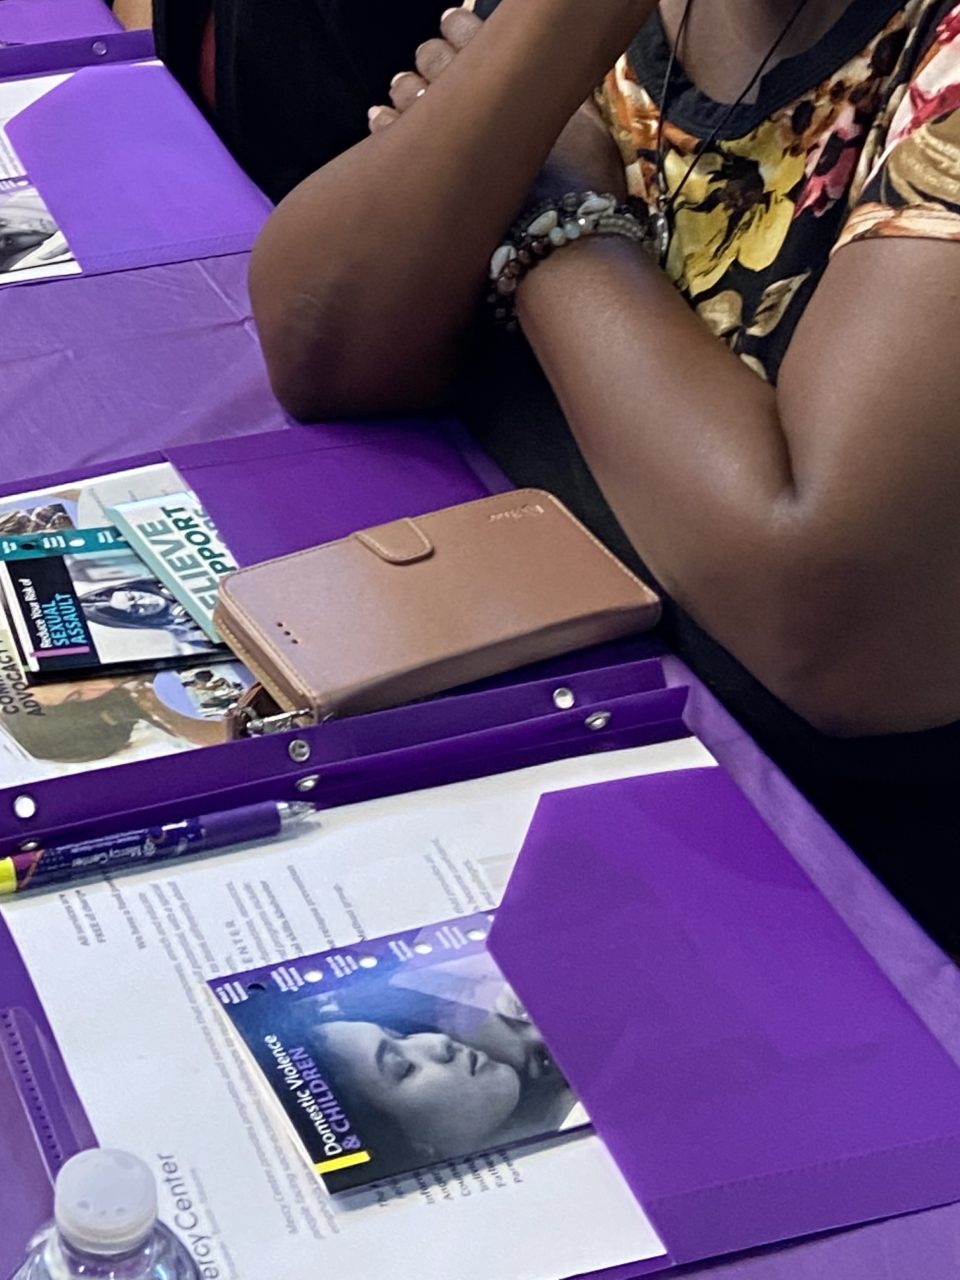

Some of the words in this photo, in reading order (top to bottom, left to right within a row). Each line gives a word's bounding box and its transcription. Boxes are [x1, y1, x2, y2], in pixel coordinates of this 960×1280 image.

[160, 507, 237, 576] PPORT
[136, 517, 218, 611] ELIEVE
[17, 577, 32, 587] of
[21, 585, 37, 601] Risk
[28, 601, 42, 619] Your
[41, 599, 69, 647] SEXUAL
[54, 593, 87, 643] ASSAULT
[32, 618, 52, 648] Reduce
[286, 864, 315, 905] prevention
[112, 892, 127, 910] food
[64, 904, 84, 935] services
[83, 912, 96, 922] of
[89, 921, 107, 944] FREE
[125, 915, 140, 935] have
[152, 920, 165, 935] and
[279, 920, 296, 942] skills
[77, 934, 90, 948] All
[133, 935, 146, 950] We
[227, 917, 250, 963] ENTER
[245, 919, 270, 962] formation,
[191, 1005, 205, 1024] that
[201, 1025, 221, 1061] services
[215, 1062, 229, 1080] and
[262, 1033, 303, 1091] Violence
[288, 1045, 349, 1134] CHILDREN
[295, 1088, 343, 1155] Domestic
[244, 1126, 271, 1168] provides
[340, 1133, 361, 1151] &
[263, 1168, 284, 1203] Center
[412, 1171, 435, 1204] Inform
[157, 1152, 220, 1280] ercyCenter
[279, 1203, 299, 1235] Mercy
